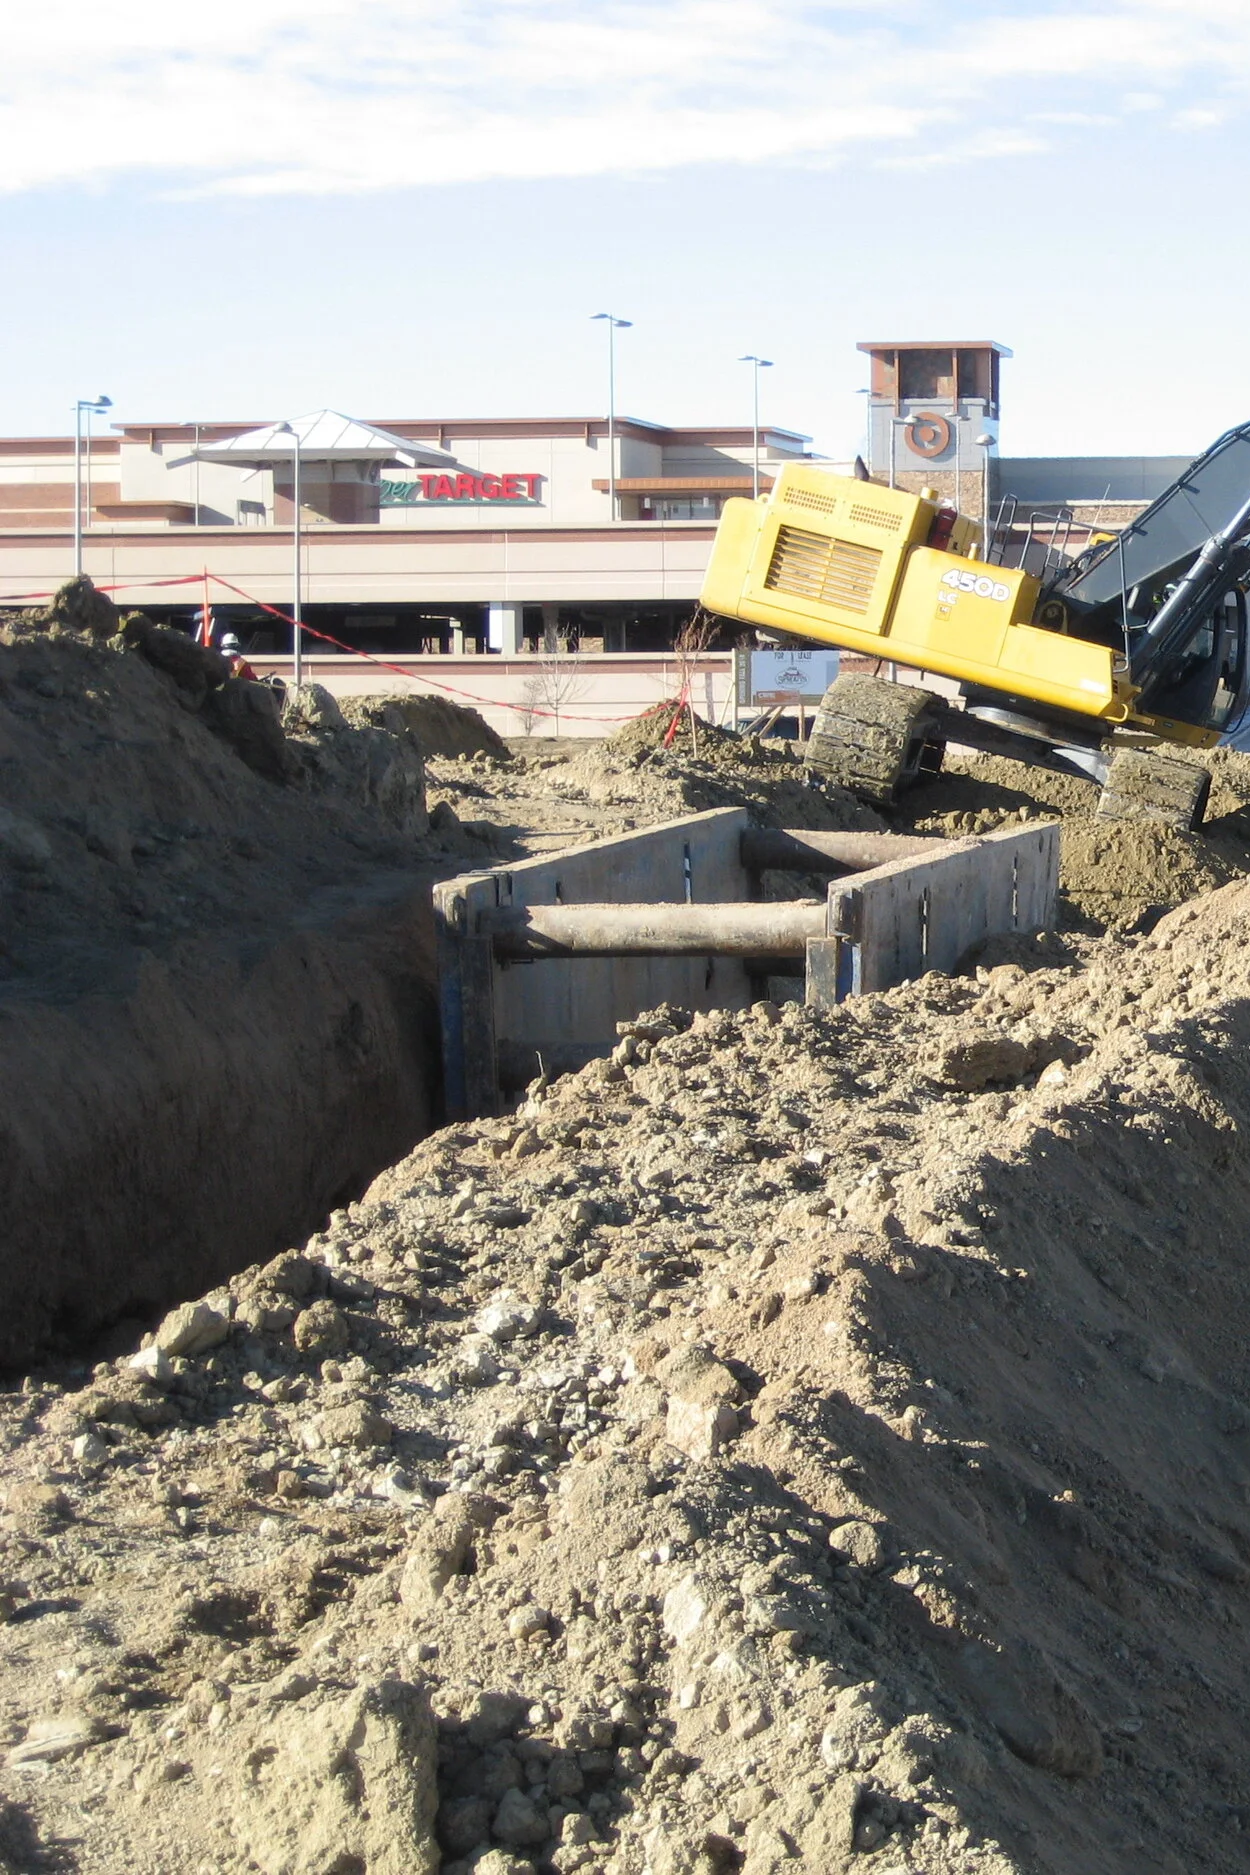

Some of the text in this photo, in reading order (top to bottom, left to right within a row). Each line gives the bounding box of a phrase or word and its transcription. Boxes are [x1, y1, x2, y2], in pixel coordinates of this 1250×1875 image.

[417, 473, 542, 500] TARGET
[938, 590, 958, 605] LC
[940, 568, 1011, 602] 450D
